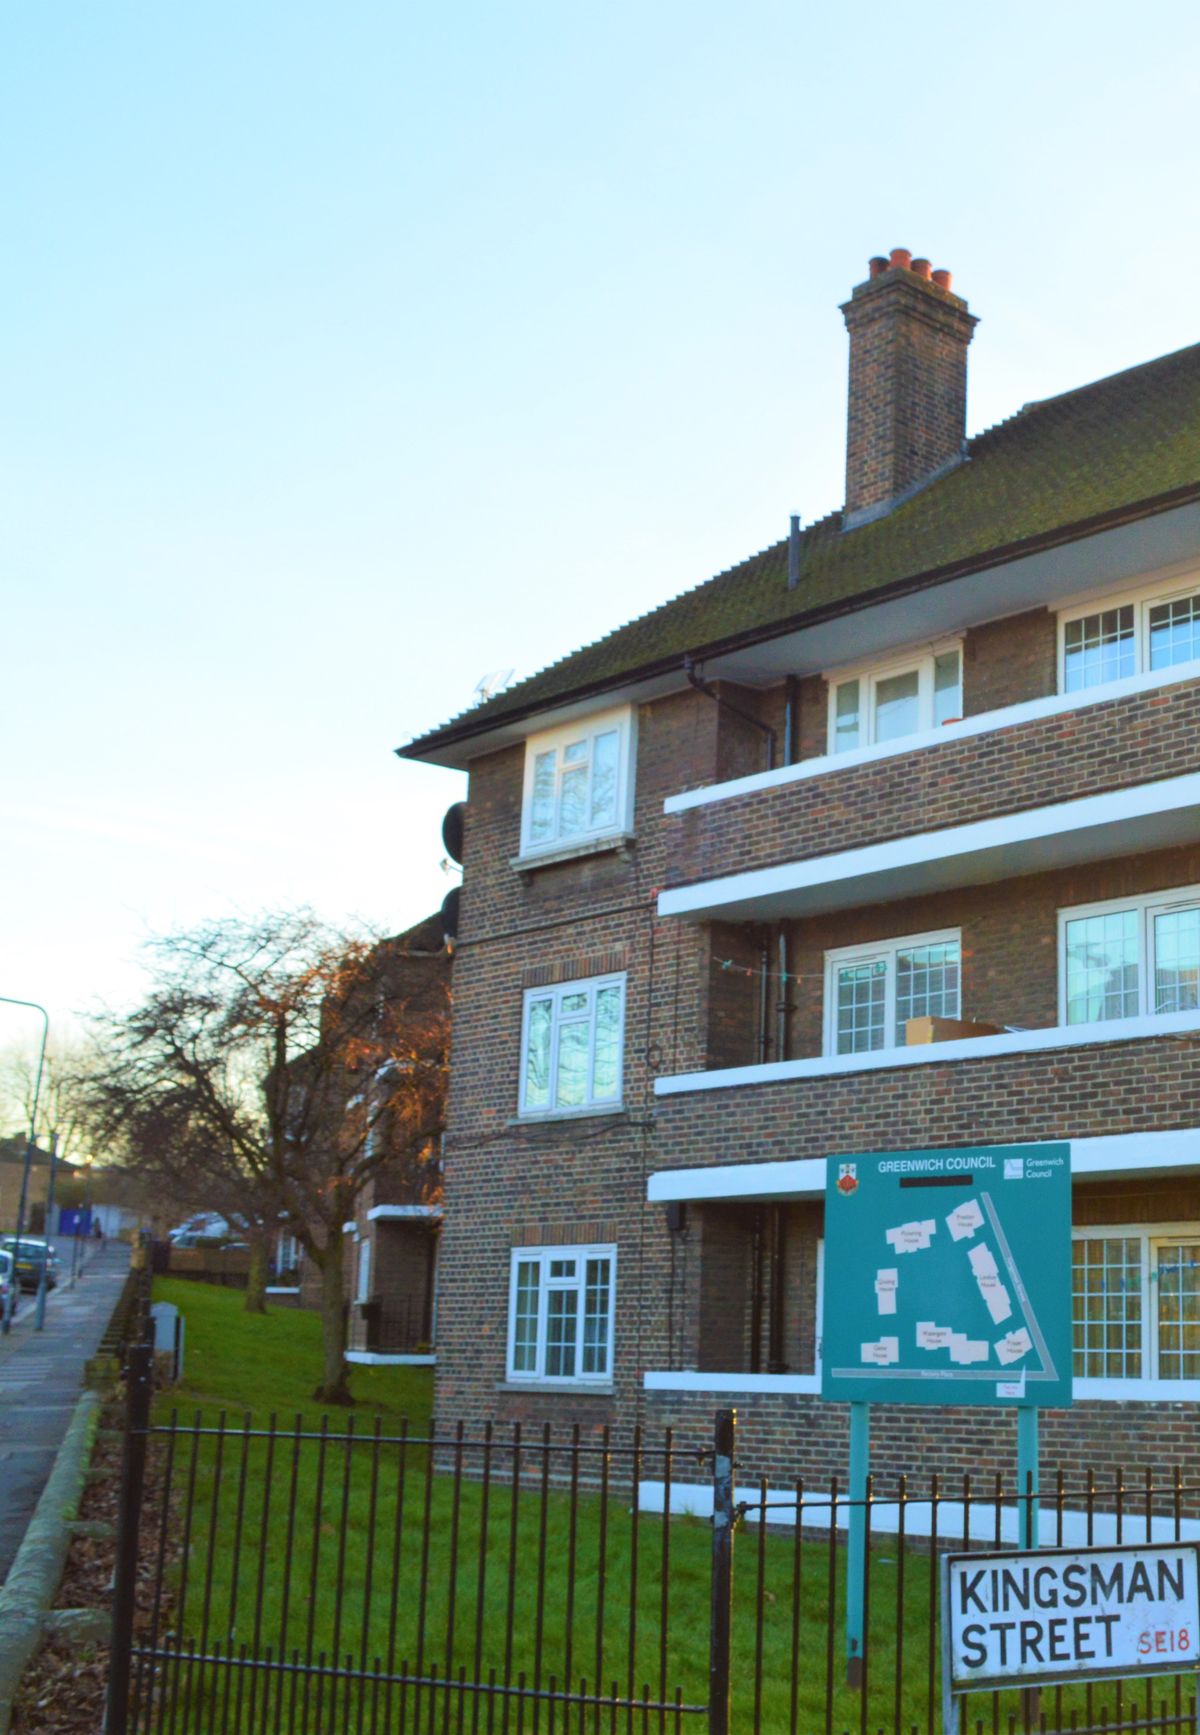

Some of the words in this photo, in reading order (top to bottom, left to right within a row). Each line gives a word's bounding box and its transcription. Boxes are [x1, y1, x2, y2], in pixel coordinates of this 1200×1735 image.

[878, 1158, 944, 1173] GREENWICH
[946, 1156, 996, 1170] COUNCIL
[1026, 1157, 1064, 1167] Greenwich
[1026, 1169, 1052, 1178] Council
[960, 1558, 1185, 1615] KINGSMAN
[961, 1613, 1121, 1669] STREET
[1137, 1628, 1190, 1655] SE18
